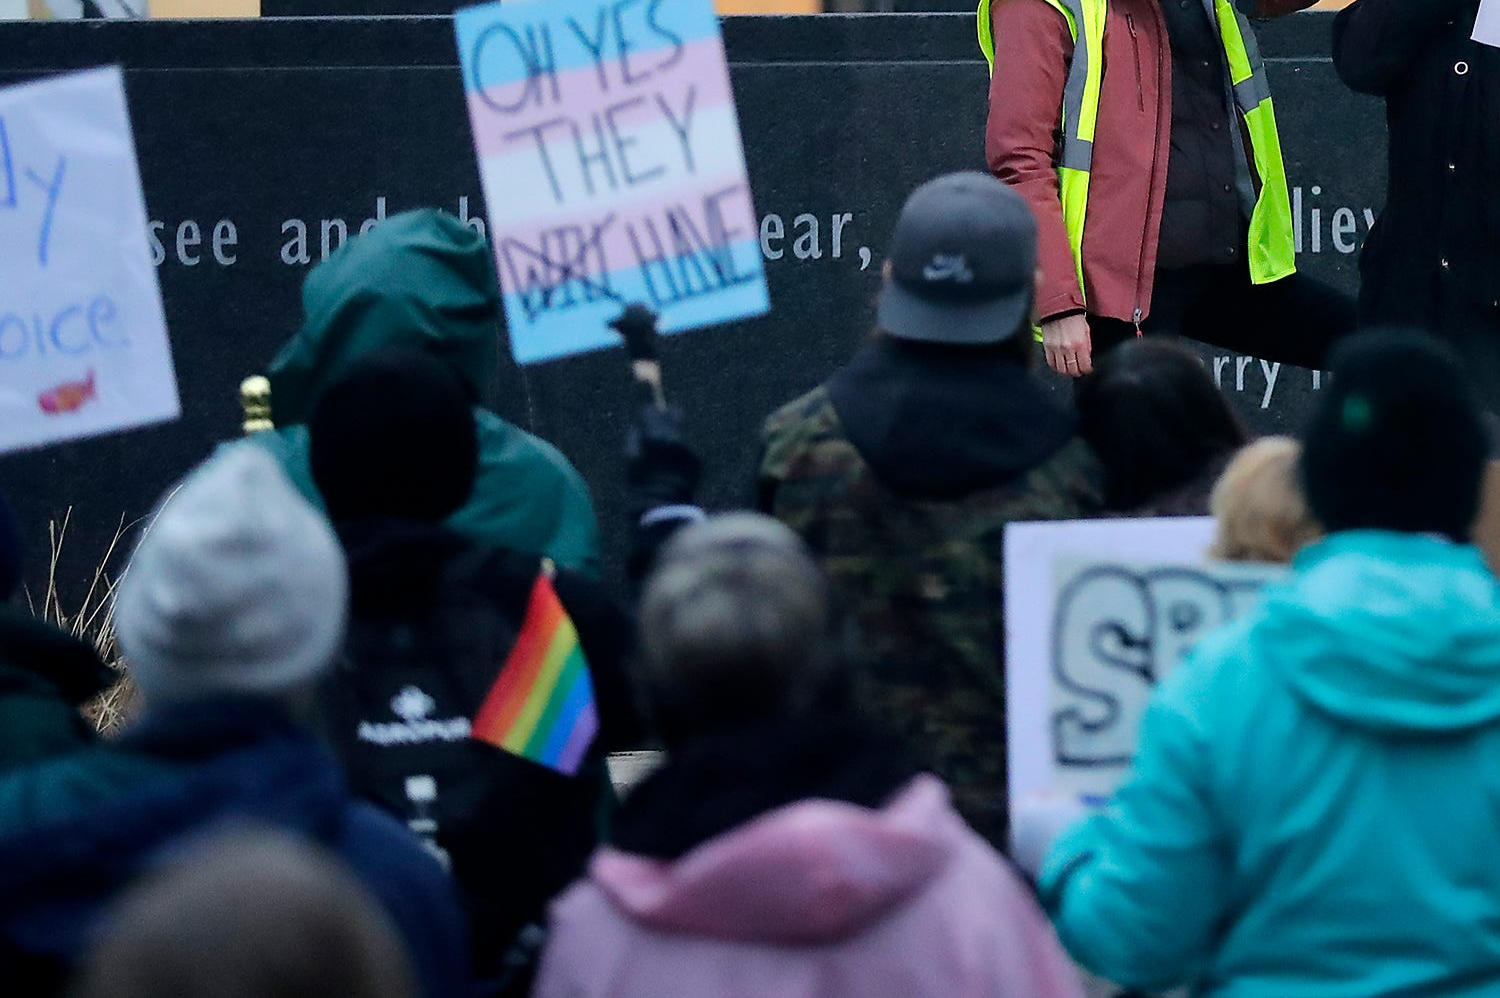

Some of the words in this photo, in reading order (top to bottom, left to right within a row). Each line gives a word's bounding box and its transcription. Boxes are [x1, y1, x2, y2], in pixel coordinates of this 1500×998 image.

[471, 19, 561, 115] OH
[501, 83, 699, 205] THEY
[759, 212, 872, 271] ear,
[1213, 355, 1281, 409] rry
